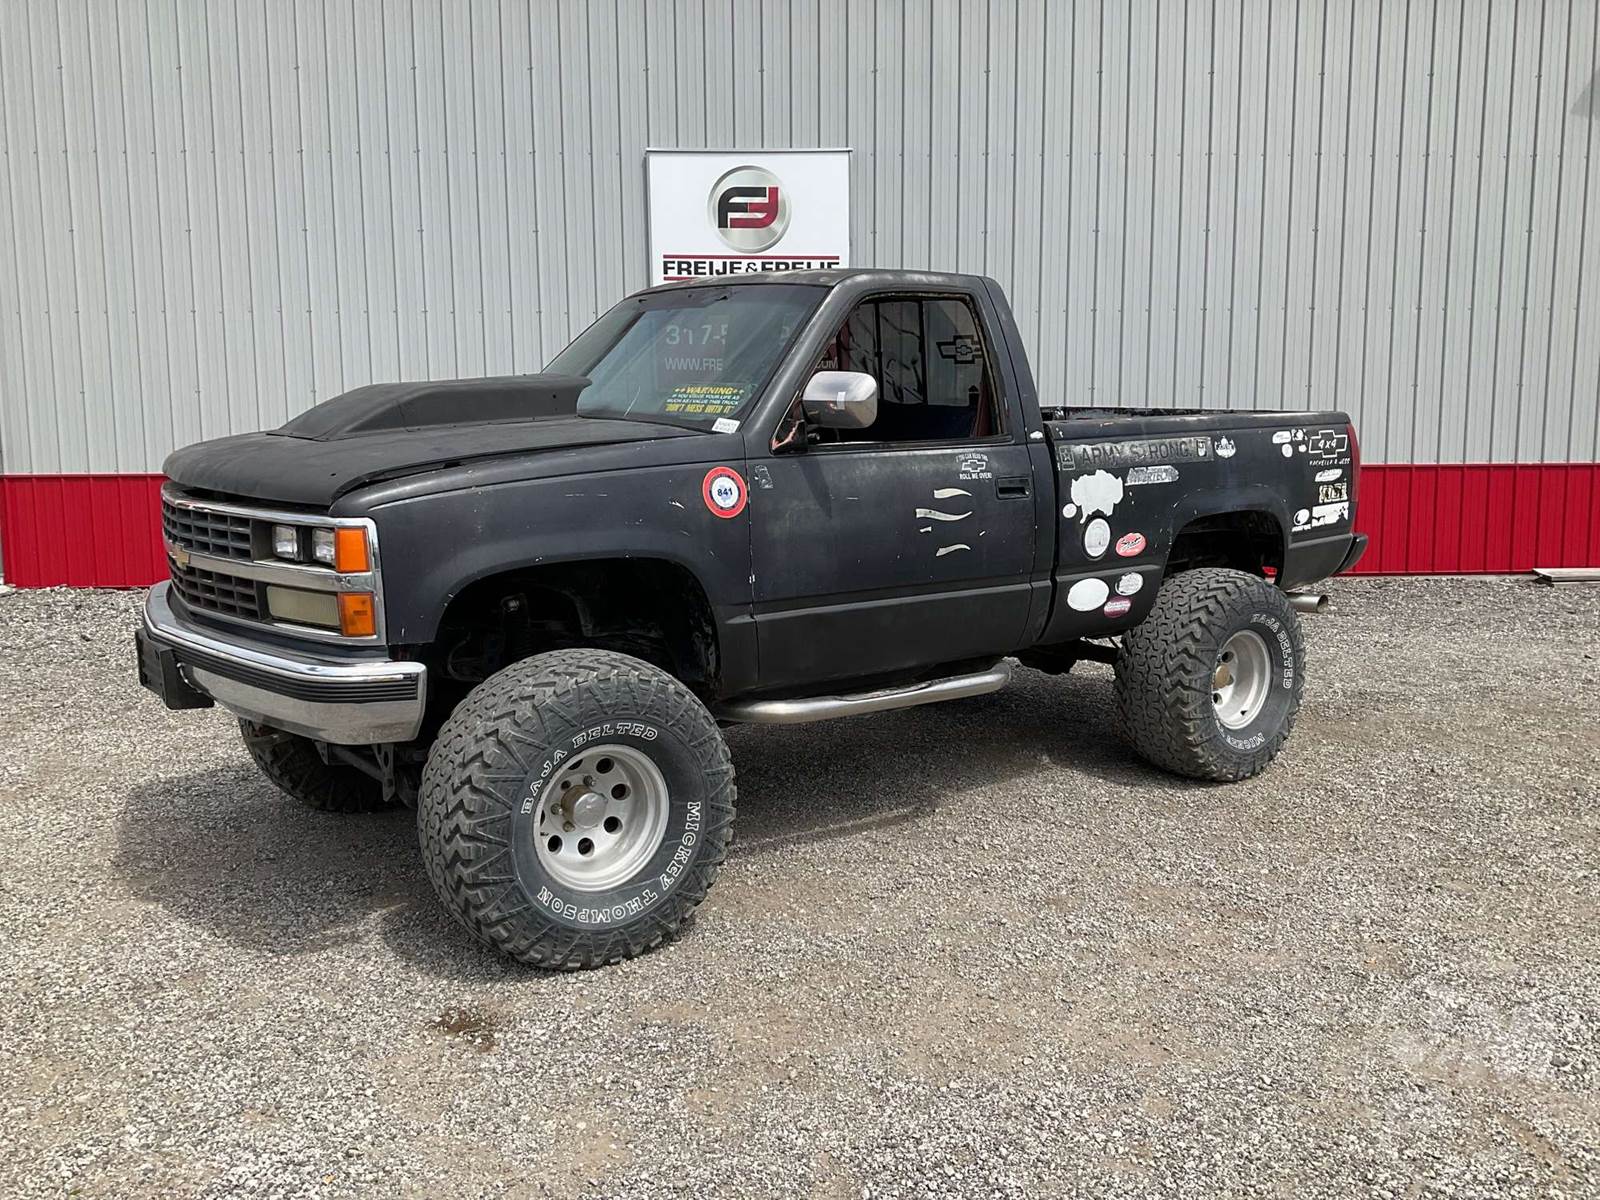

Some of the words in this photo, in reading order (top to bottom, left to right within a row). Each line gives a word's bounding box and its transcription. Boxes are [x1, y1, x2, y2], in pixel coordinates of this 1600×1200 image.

[663, 260, 742, 275] FREIJE
[1081, 444, 1124, 467] ARMY
[717, 487, 733, 497] 841
[1276, 630, 1294, 689] BELTED
[520, 749, 568, 815] BAJA
[572, 722, 658, 749] BELTED
[660, 801, 702, 890] MICKEY
[536, 885, 658, 925] THOMPSON
